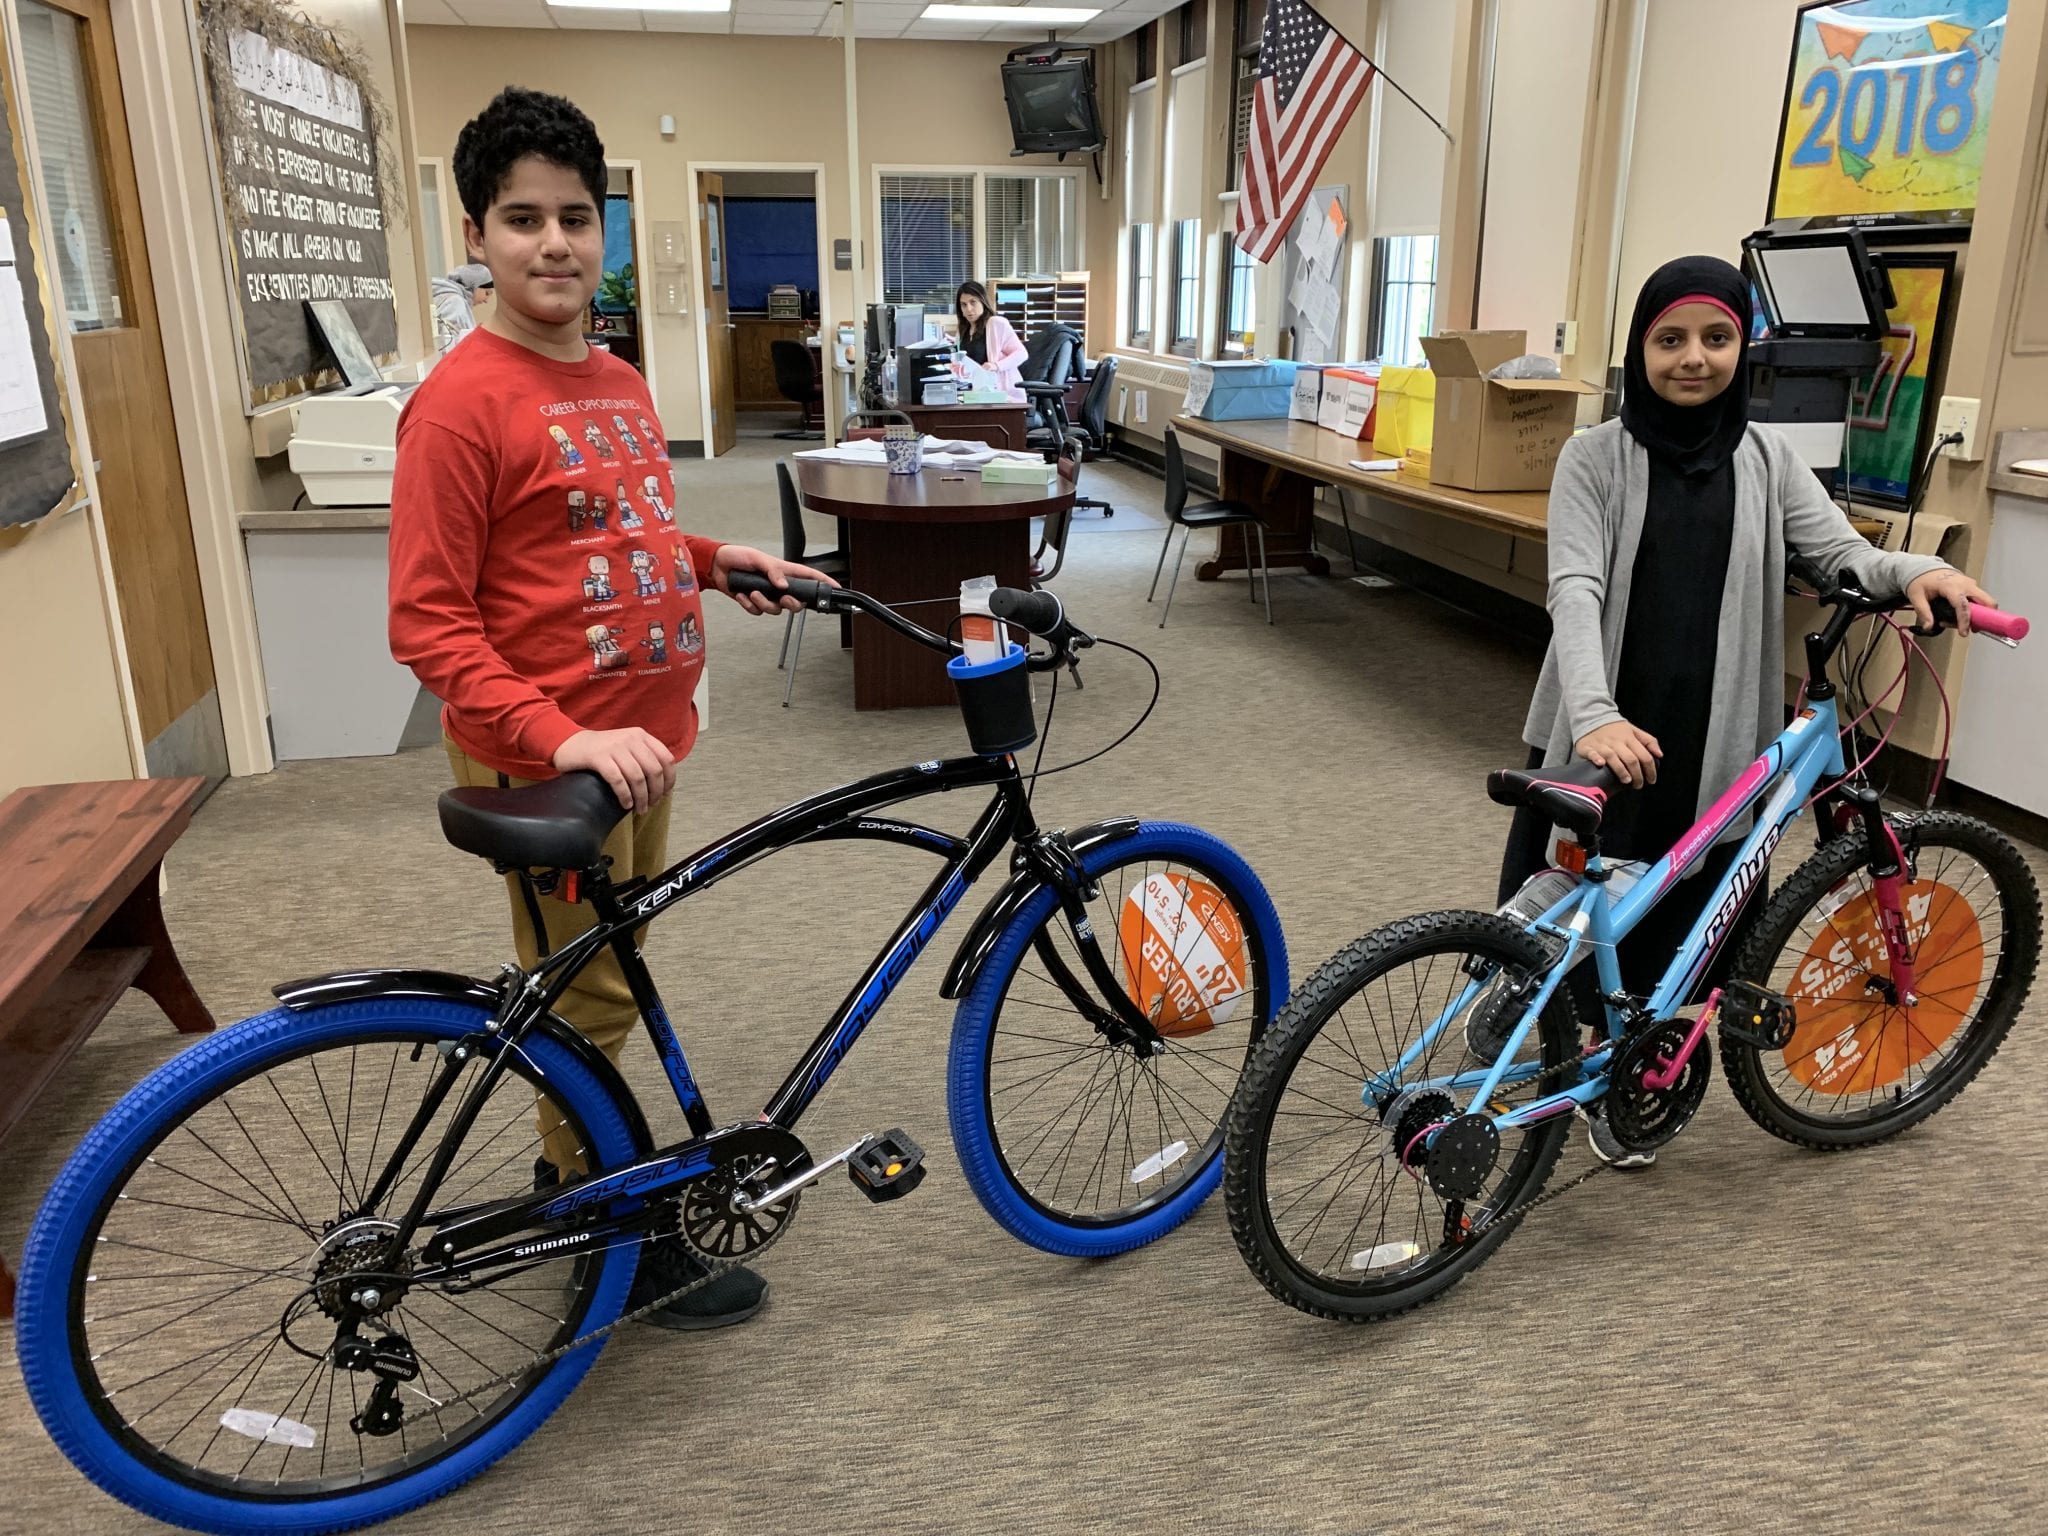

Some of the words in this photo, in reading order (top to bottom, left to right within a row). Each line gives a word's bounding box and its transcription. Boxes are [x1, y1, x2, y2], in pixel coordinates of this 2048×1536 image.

[1790, 42, 1981, 168] 2018
[260, 104, 286, 138] MOST
[289, 115, 320, 148] HUMBLE
[277, 147, 323, 185] EXPRESSED
[336, 167, 350, 193] THE
[351, 171, 375, 197] TONGUE
[239, 184, 259, 214] AND
[259, 187, 281, 217] THE
[281, 191, 314, 223] HIGHEST
[316, 199, 337, 225] FORM
[336, 201, 347, 226] OF
[347, 205, 382, 231] KNOWLEDGE
[241, 228, 252, 259] IS
[252, 229, 279, 259] WHAT
[282, 232, 303, 259] WILL
[303, 234, 333, 261] APPEAR
[332, 237, 344, 261] ON
[345, 239, 363, 263] YOUR
[310, 273, 328, 299] AND
[327, 274, 353, 299] FACIAL
[539, 402, 579, 417] CAREER
[578, 399, 641, 412] OPPORTUNITIES
[565, 467, 587, 477] FARMER
[570, 536, 606, 546] MERCHANT
[582, 603, 623, 613] BLACKSMITH
[589, 670, 627, 680] ENCHANTER
[638, 665, 672, 676] LUMBERJACK
[858, 821, 917, 835] COMFORT
[637, 864, 698, 916] KENT
[1705, 824, 1781, 950] rallye
[1204, 906, 1232, 943] KENT
[1142, 933, 1200, 1022] CRUISER
[649, 1006, 702, 1104] COMFORT
[545, 1147, 711, 1219] BAYSIDE
[514, 1232, 590, 1257] SHIMANO
